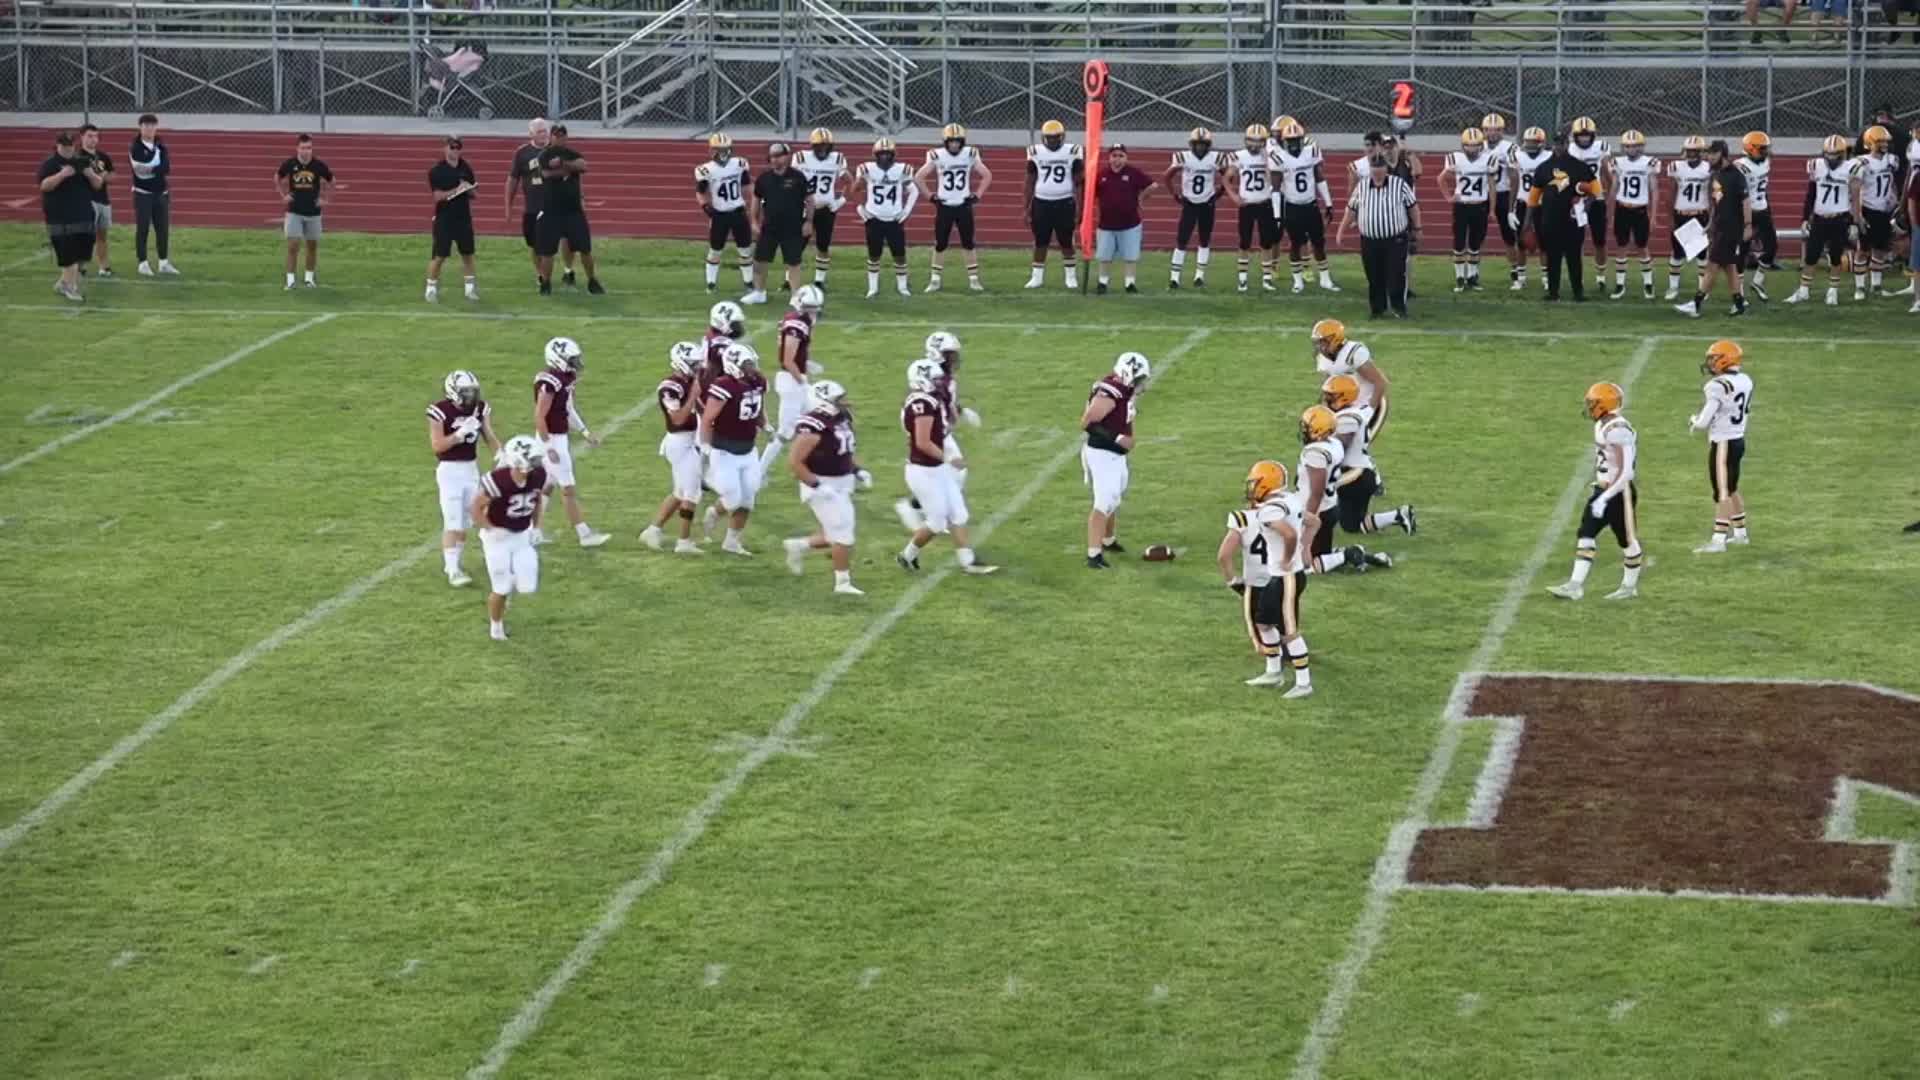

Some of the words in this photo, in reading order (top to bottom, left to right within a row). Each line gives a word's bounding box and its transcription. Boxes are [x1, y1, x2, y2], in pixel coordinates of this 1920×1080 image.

[1392, 82, 1416, 119] 2
[943, 169, 967, 191] 33
[1041, 165, 1066, 184] 79
[1191, 174, 1205, 195] 8
[1242, 169, 1265, 192] 25
[1295, 171, 1308, 193] 6
[717, 181, 740, 202] 40
[872, 185, 897, 206] 54
[1458, 176, 1483, 196] 24
[1623, 176, 1641, 199] 19
[1682, 182, 1702, 203] 41
[1820, 184, 1840, 205] 71
[1876, 174, 1893, 198] 17
[1249, 533, 1268, 565] 4
